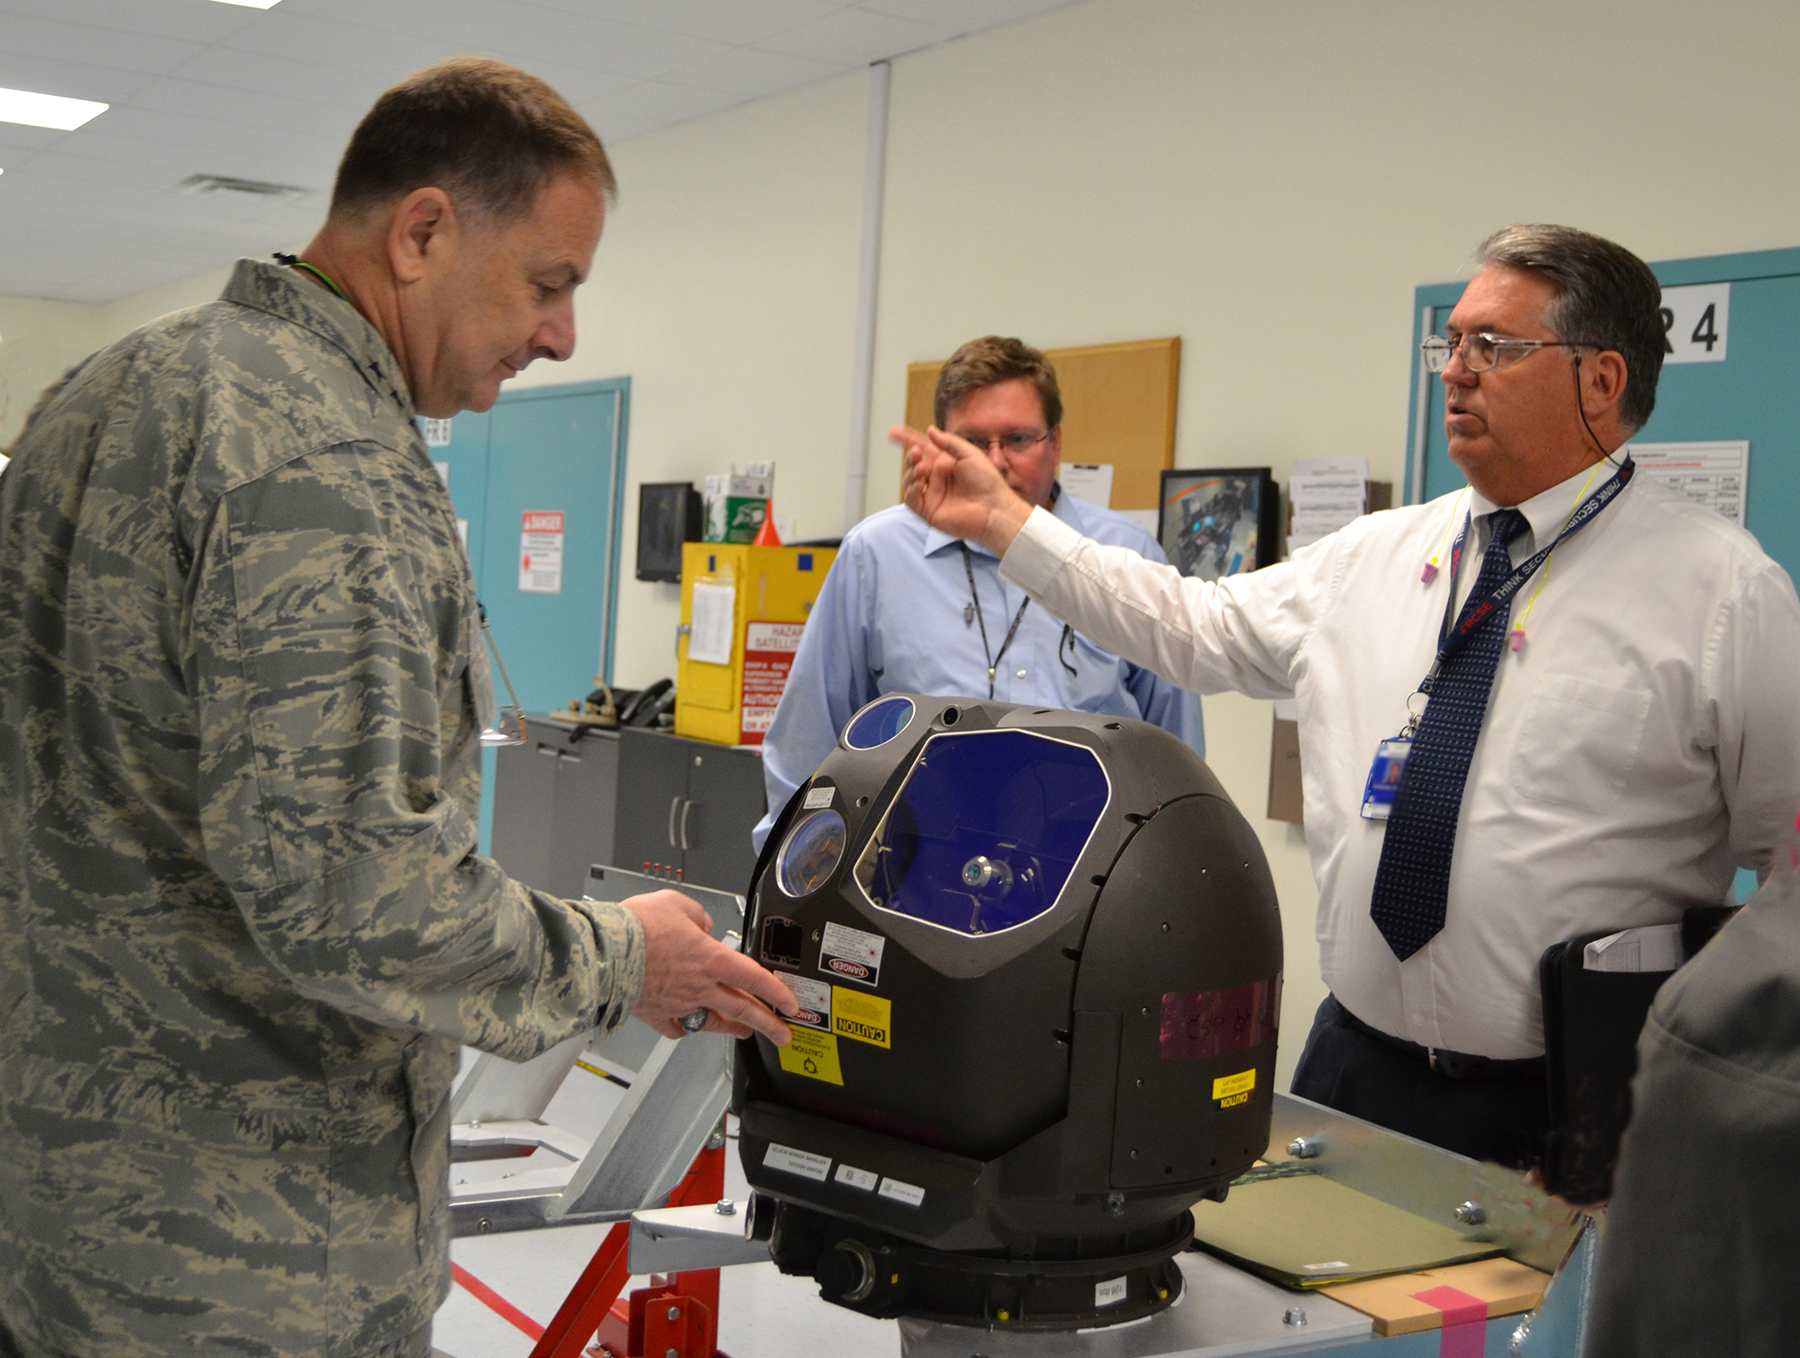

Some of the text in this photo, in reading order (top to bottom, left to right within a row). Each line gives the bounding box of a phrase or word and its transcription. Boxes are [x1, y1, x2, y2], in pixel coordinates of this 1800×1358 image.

[1690, 302, 1719, 352] 4
[1600, 478, 1620, 504] THINK
[532, 515, 561, 530] DANGER
[1492, 573, 1524, 601] THINK
[1460, 600, 1493, 635] FRCSE
[832, 960, 865, 976] DANGER
[838, 1018, 884, 1041] CAUTION
[792, 1045, 823, 1058] CAUTION
[1220, 1093, 1249, 1109] CAUTION
